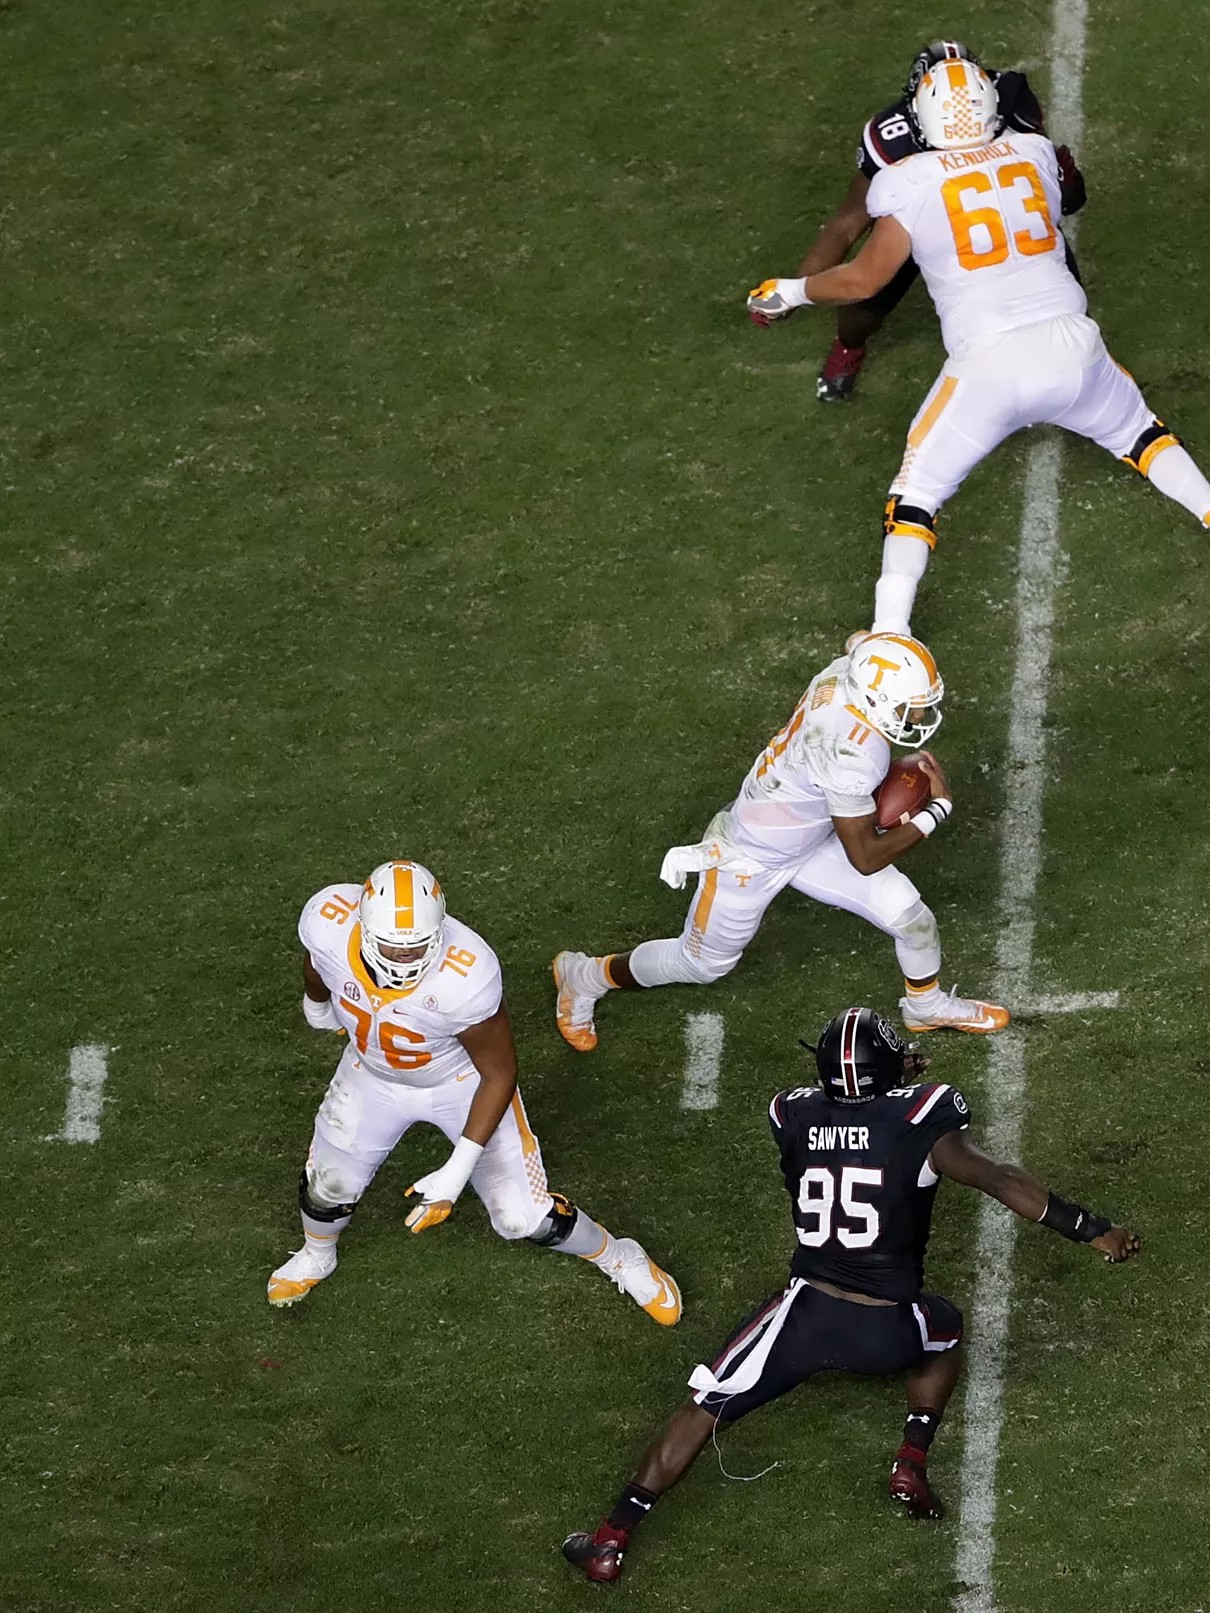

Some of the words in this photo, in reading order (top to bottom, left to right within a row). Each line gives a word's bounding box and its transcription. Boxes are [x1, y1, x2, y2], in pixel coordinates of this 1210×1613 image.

[878, 113, 910, 141] 18
[937, 141, 1019, 172] KENDRICK
[940, 161, 1057, 271] 63
[868, 655, 901, 692] T
[847, 722, 872, 746] 11
[735, 873, 752, 888] T
[320, 893, 360, 925] 76
[438, 945, 476, 978] 76
[371, 994, 383, 1008] T
[339, 996, 432, 1071] 76
[808, 1126, 870, 1151] SAWYER
[796, 1166, 884, 1249] 95
